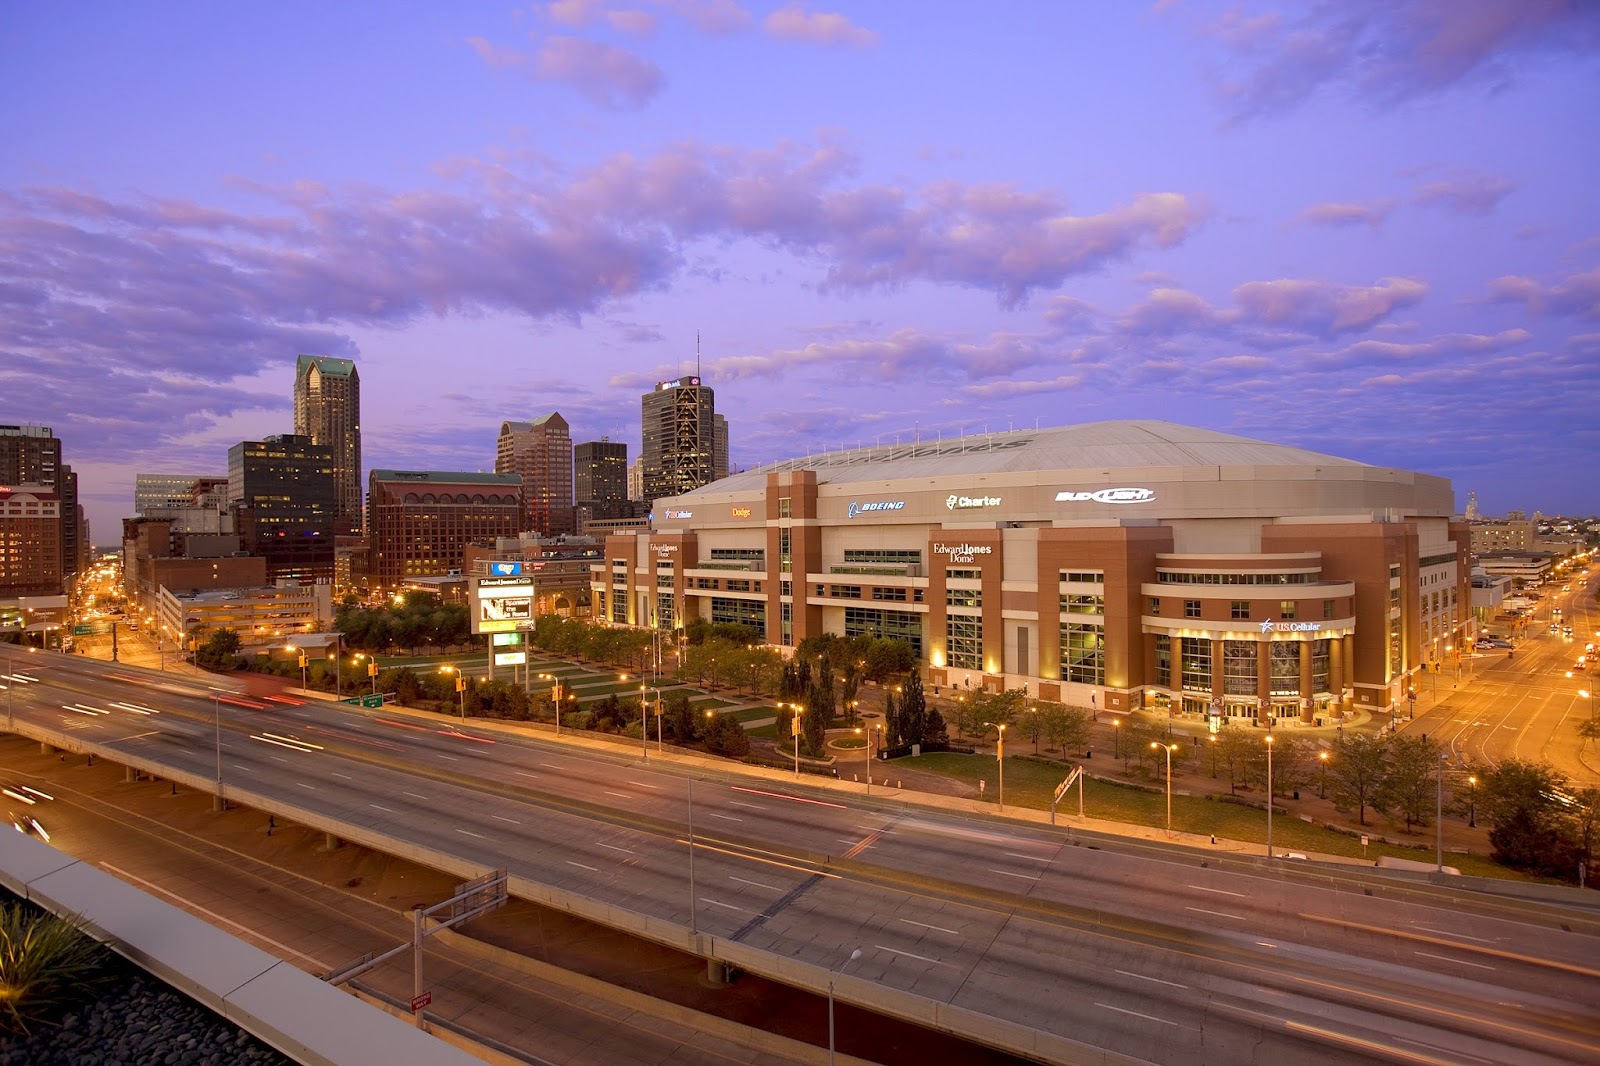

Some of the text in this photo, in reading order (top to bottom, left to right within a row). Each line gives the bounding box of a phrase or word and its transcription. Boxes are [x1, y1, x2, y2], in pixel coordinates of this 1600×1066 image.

[1055, 490, 1154, 501] BUD LIGHT
[862, 501, 905, 511] BOEING
[958, 496, 1001, 507] Charter
[732, 508, 750, 518] Dodge
[950, 553, 975, 563] Dome
[1290, 623, 1320, 631] Cellular
